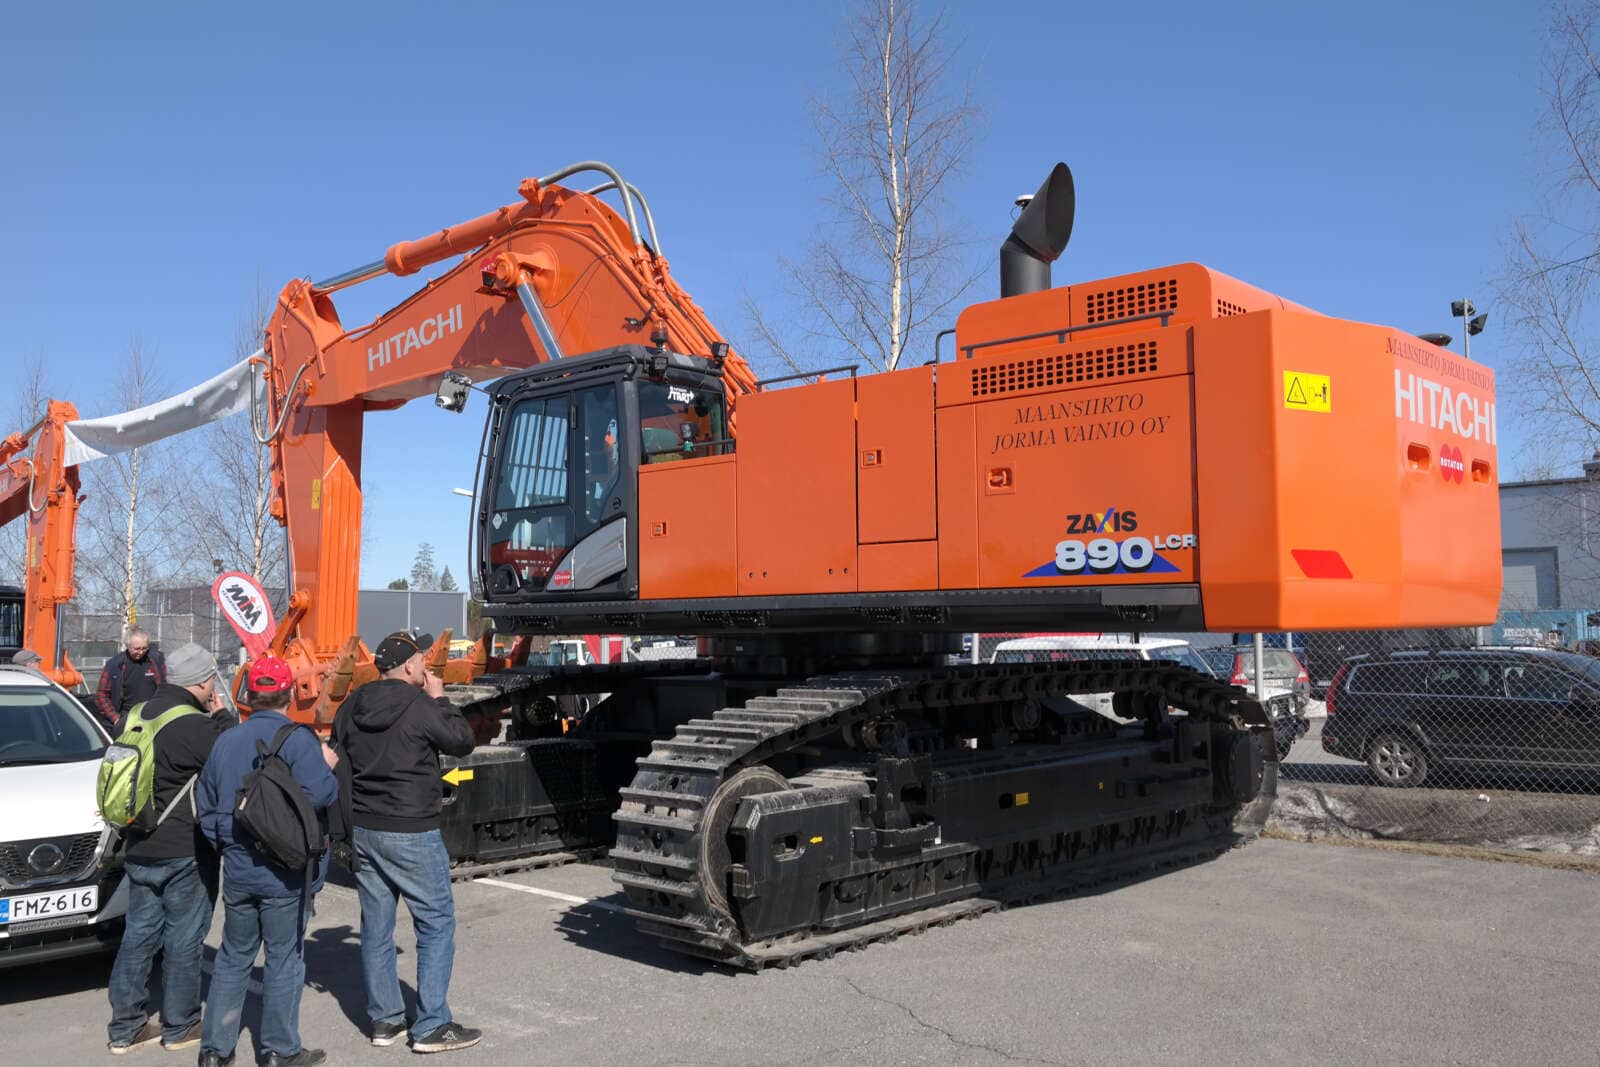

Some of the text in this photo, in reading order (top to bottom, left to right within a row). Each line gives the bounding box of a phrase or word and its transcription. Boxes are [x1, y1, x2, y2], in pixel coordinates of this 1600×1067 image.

[367, 303, 463, 372] HITACHI
[1014, 392, 1144, 425] MAANSIIRTO
[1394, 367, 1497, 446] HITACHI
[992, 415, 1172, 455] JORMA VAINIO OY
[1066, 507, 1138, 534] ZAXIS
[1055, 533, 1198, 575] 890 LCR
[14, 891, 92, 917] FMZ-616
